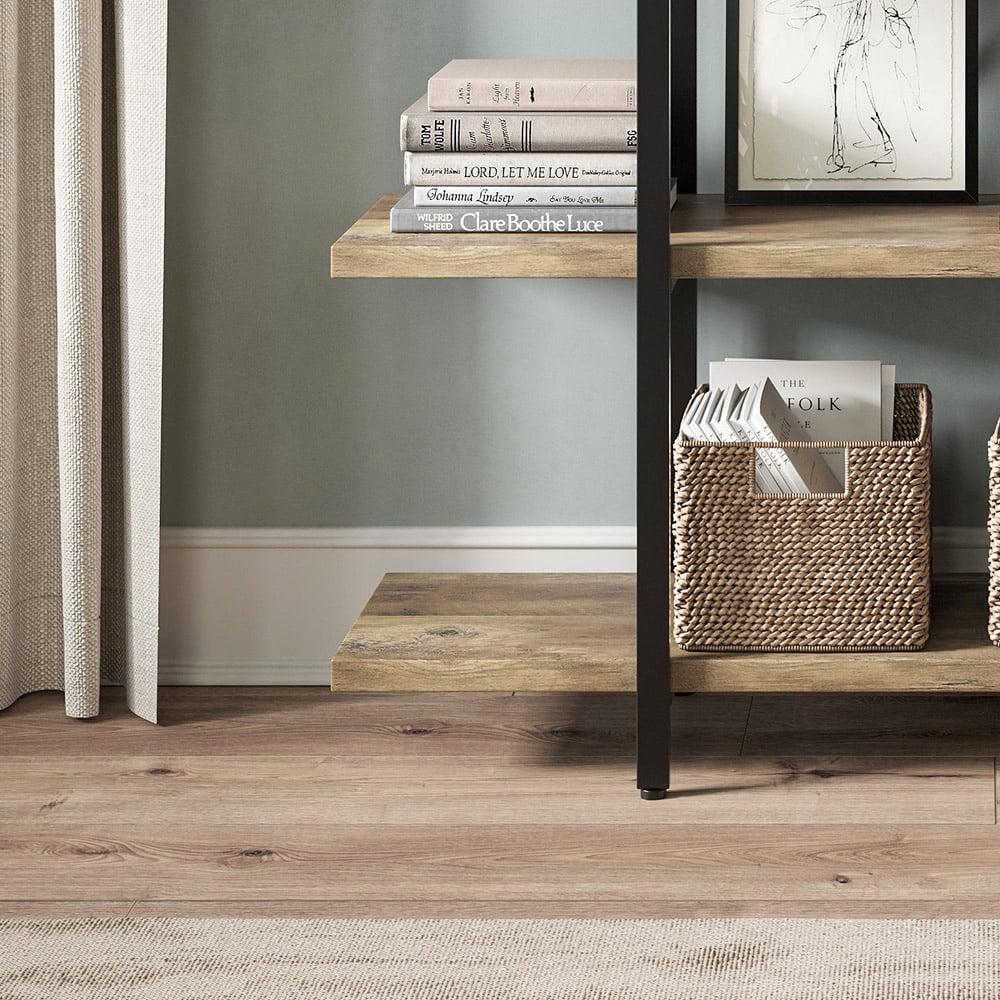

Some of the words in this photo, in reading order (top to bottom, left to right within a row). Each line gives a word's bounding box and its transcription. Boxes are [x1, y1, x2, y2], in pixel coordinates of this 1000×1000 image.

[421, 125, 431, 145] TOM
[434, 119, 445, 152] WOLFE
[627, 129, 637, 147] FSG
[464, 166, 499, 180] LORD,
[502, 166, 525, 178] LET
[527, 166, 546, 178] ME
[548, 166, 579, 179] LOVE
[427, 188, 473, 201] Johanna
[476, 189, 515, 206] Lindsey
[417, 213, 454, 222] WILFRID
[423, 222, 454, 231] SHEED
[460, 211, 507, 233] Clare
[507, 213, 566, 233] Boothe
[566, 213, 605, 233] Luce
[780, 379, 805, 388] THE
